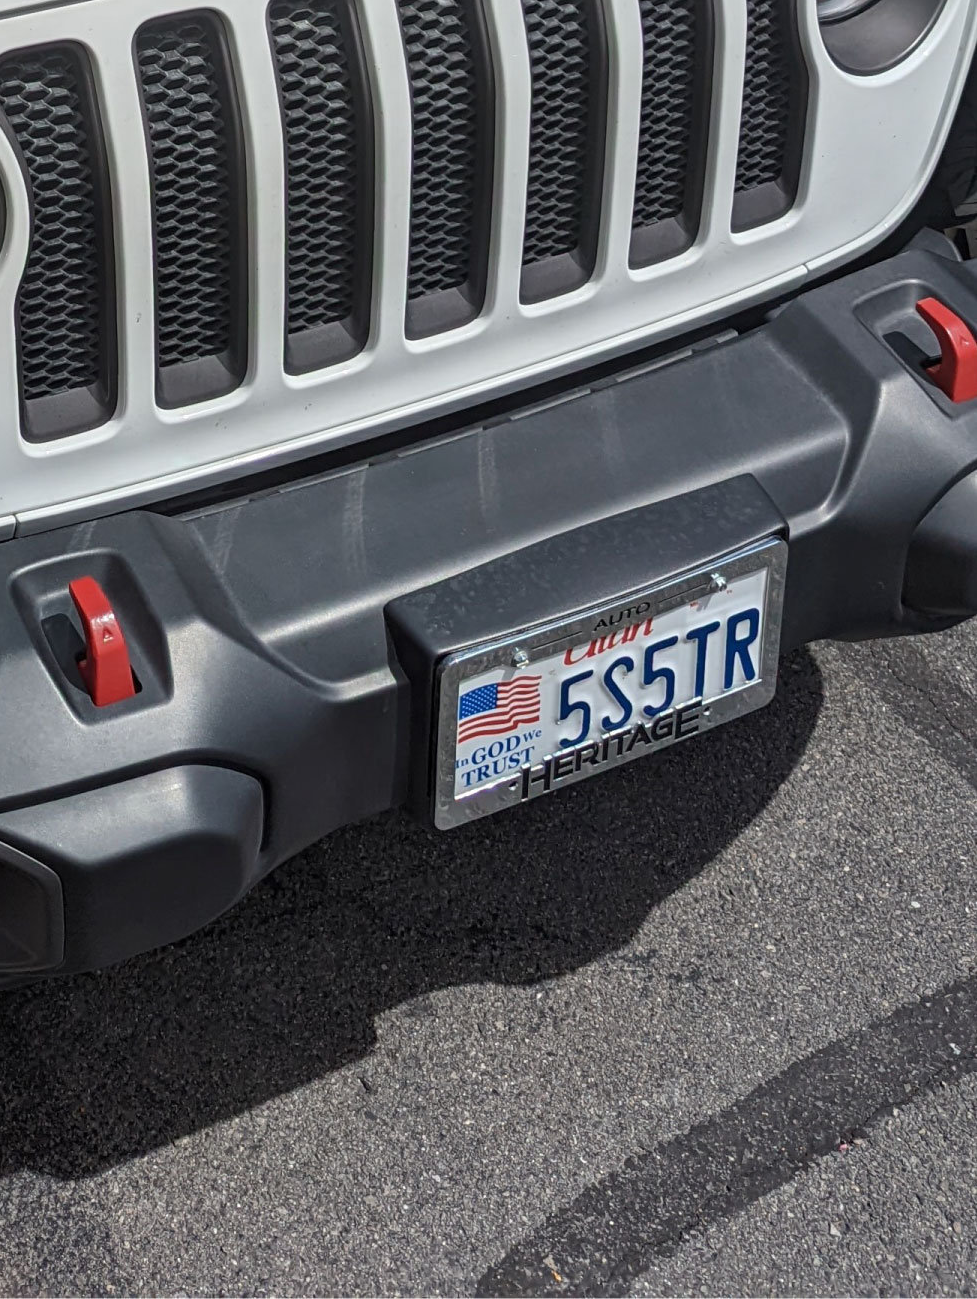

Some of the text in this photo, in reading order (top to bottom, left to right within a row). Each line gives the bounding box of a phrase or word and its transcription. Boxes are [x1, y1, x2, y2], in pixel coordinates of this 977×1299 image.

[593, 601, 651, 632] AUTO
[559, 607, 761, 749] 5S5TR
[461, 746, 535, 788] TRUST
[471, 735, 521, 765] GOD
[523, 729, 542, 743] We
[521, 698, 704, 801] HERITAGE
